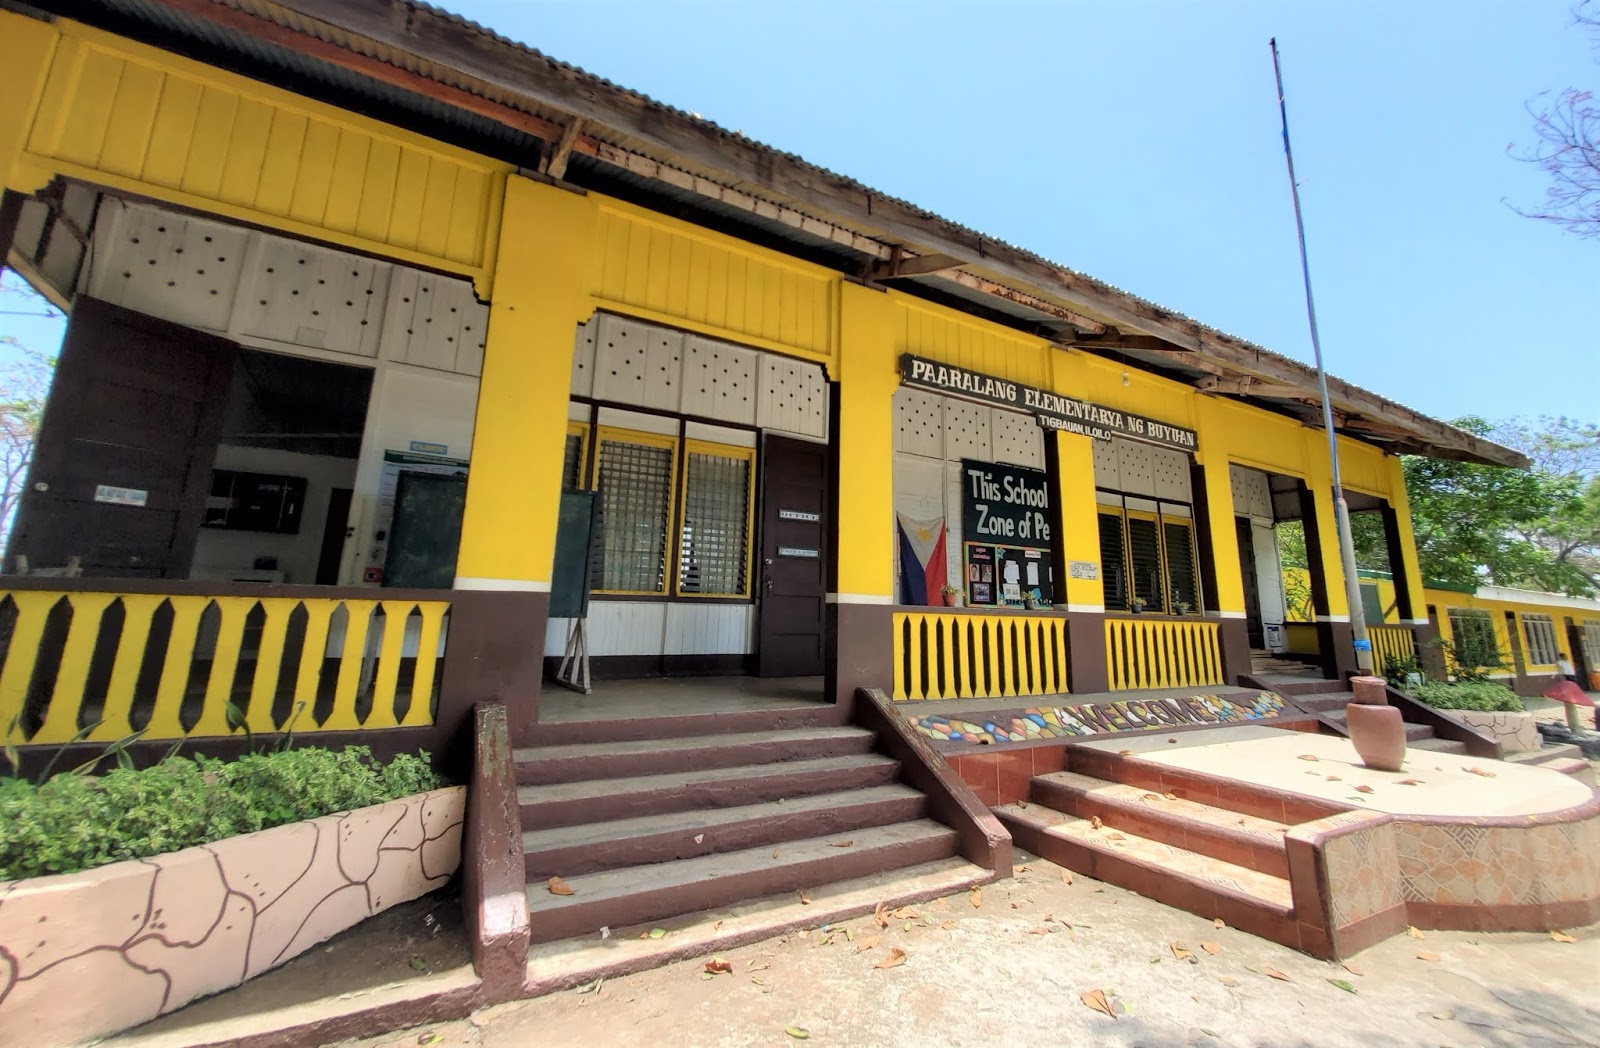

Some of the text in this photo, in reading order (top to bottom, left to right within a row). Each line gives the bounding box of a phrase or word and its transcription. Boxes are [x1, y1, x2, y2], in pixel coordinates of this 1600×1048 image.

[911, 359, 1195, 447] PAARALANG ELEMENTARYA NG BUYUAN
[967, 469, 1049, 509] This School
[975, 503, 1015, 537] Zone
[1018, 511, 1032, 539] of
[1062, 697, 1216, 732] WELCOME
